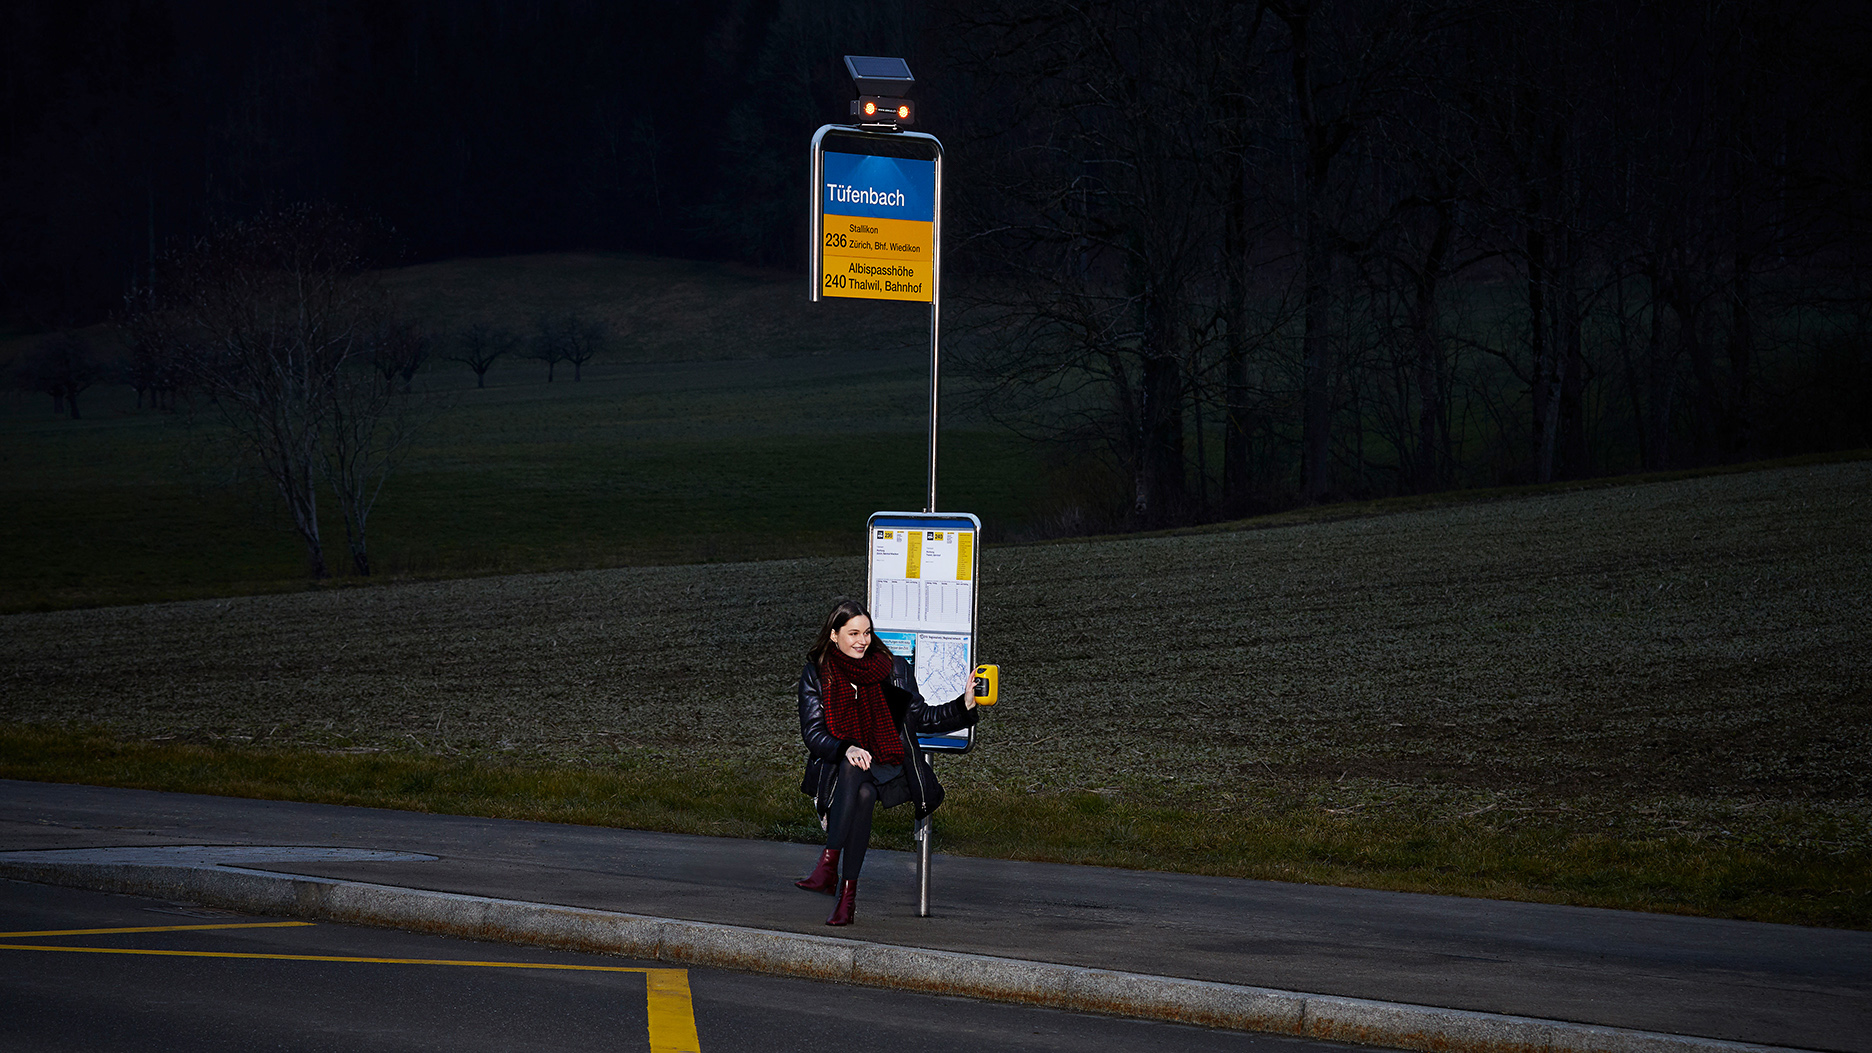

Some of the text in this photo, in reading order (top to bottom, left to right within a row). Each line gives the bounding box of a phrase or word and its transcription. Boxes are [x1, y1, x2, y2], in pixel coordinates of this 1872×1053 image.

[827, 183, 905, 207] Tüfenbach
[849, 224, 878, 234] Stallikon
[825, 233, 920, 253] 236 Zürich, Bhf. Wiedikon
[848, 262, 914, 278] Albispasshöhe
[825, 274, 922, 294] 240 Thalwil, Bahnhof
